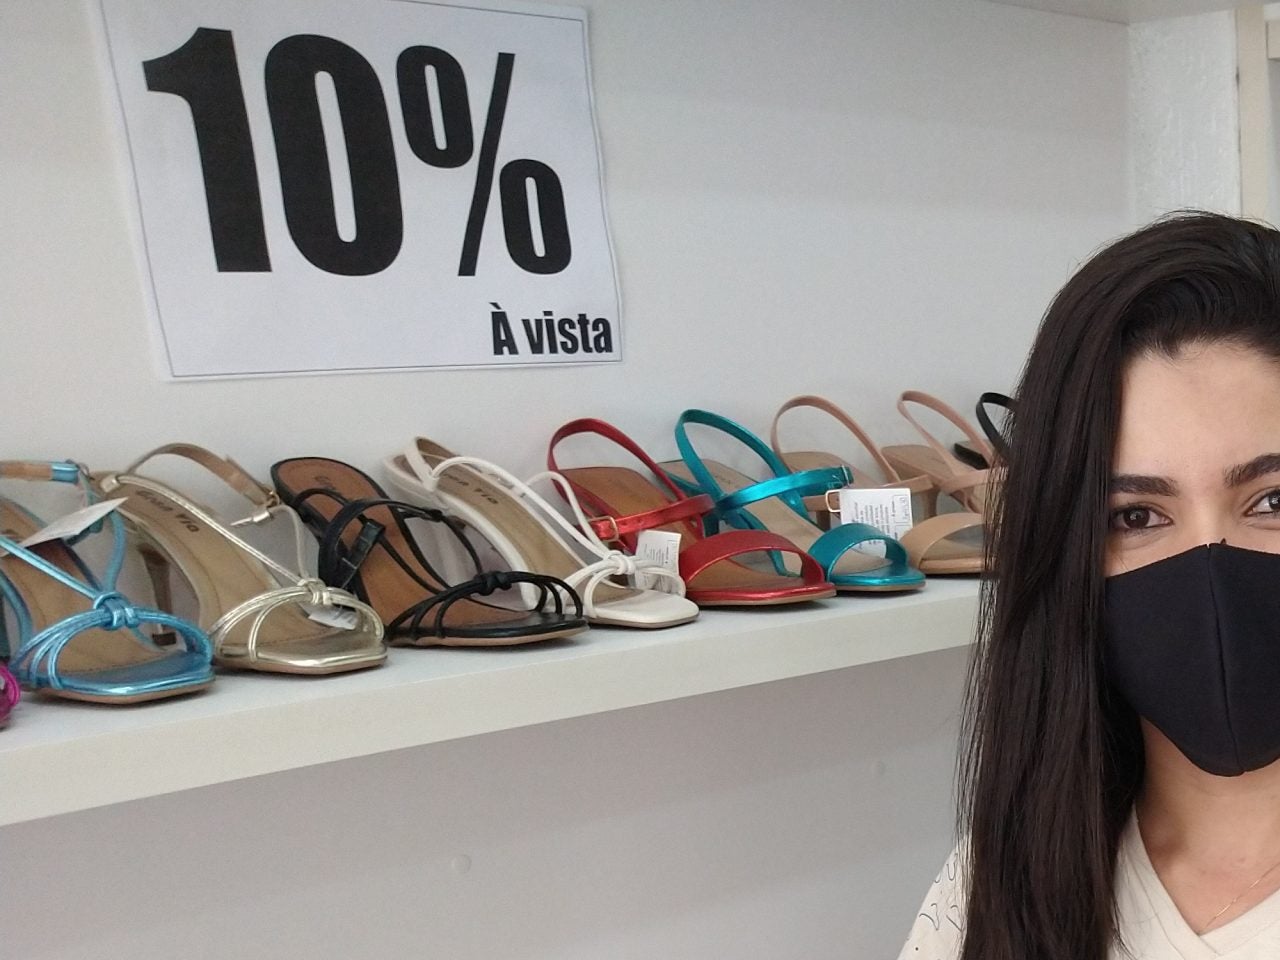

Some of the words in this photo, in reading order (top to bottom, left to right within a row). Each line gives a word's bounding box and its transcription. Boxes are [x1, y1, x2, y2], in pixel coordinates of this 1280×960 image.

[142, 27, 573, 276] 10%
[489, 302, 519, 355] À
[521, 310, 613, 355] vista
